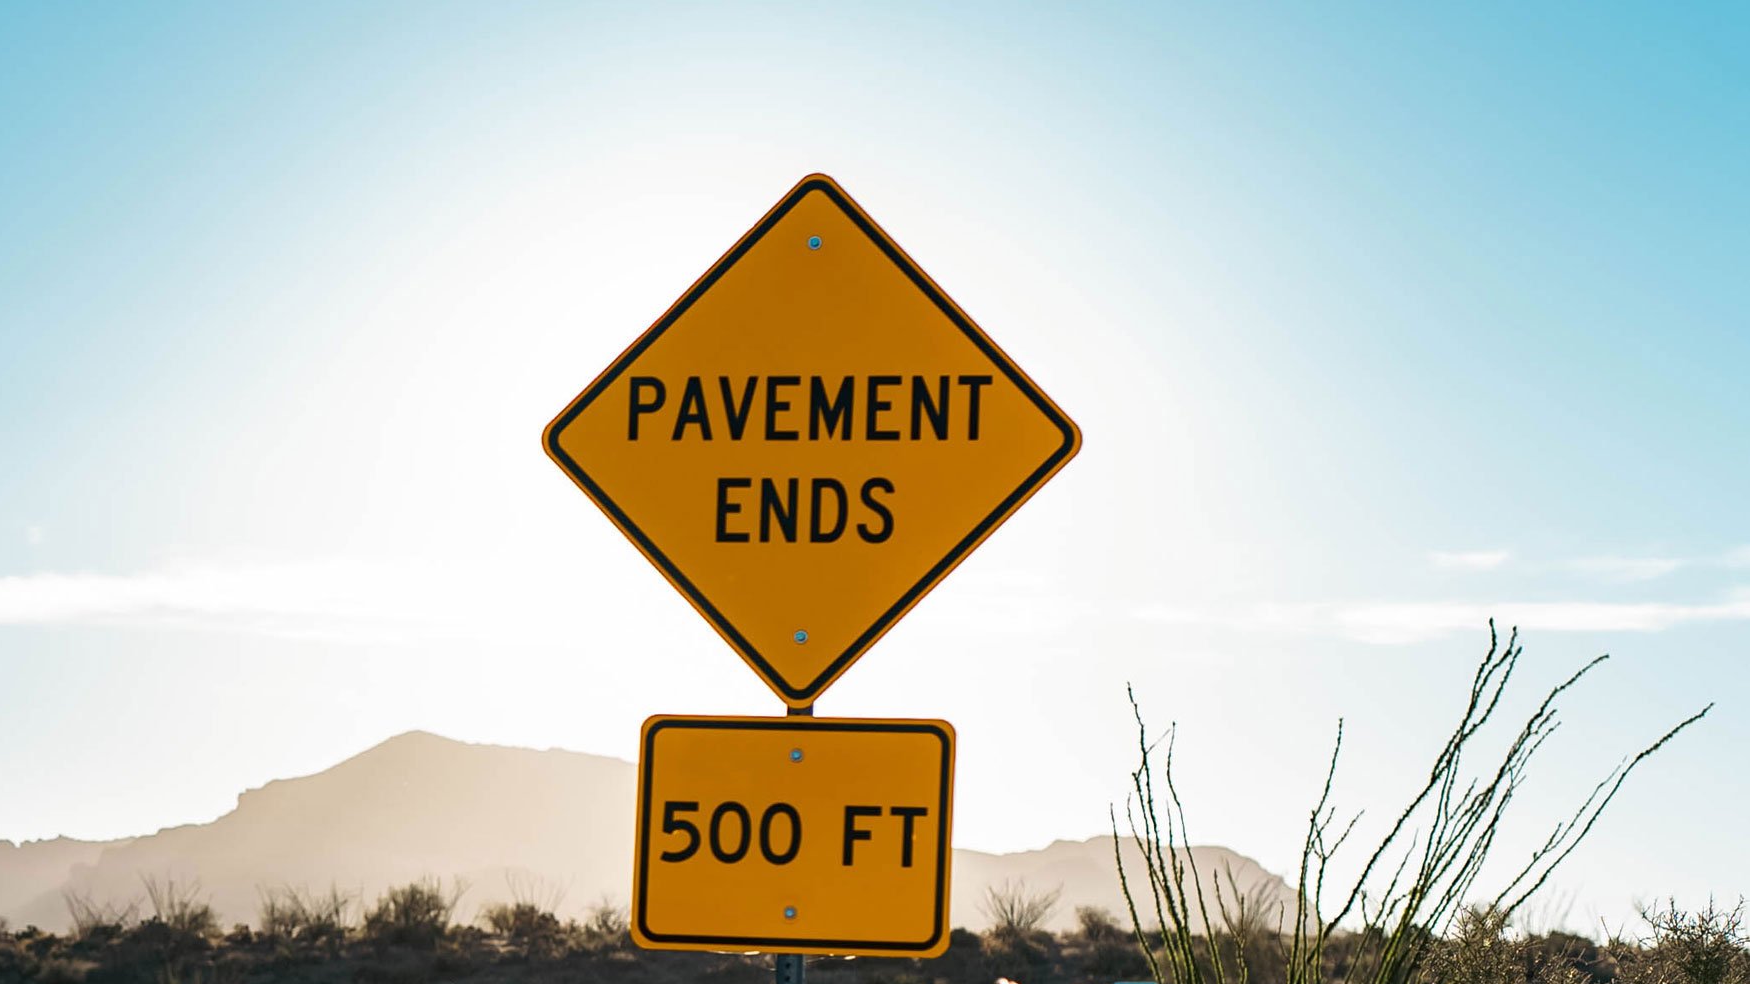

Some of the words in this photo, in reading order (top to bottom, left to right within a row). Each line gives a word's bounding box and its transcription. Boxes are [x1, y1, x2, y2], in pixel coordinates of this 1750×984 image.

[627, 374, 993, 442] PAVEMENT
[715, 476, 896, 545] ENDS
[659, 800, 803, 866] 500
[842, 805, 929, 868] FT
